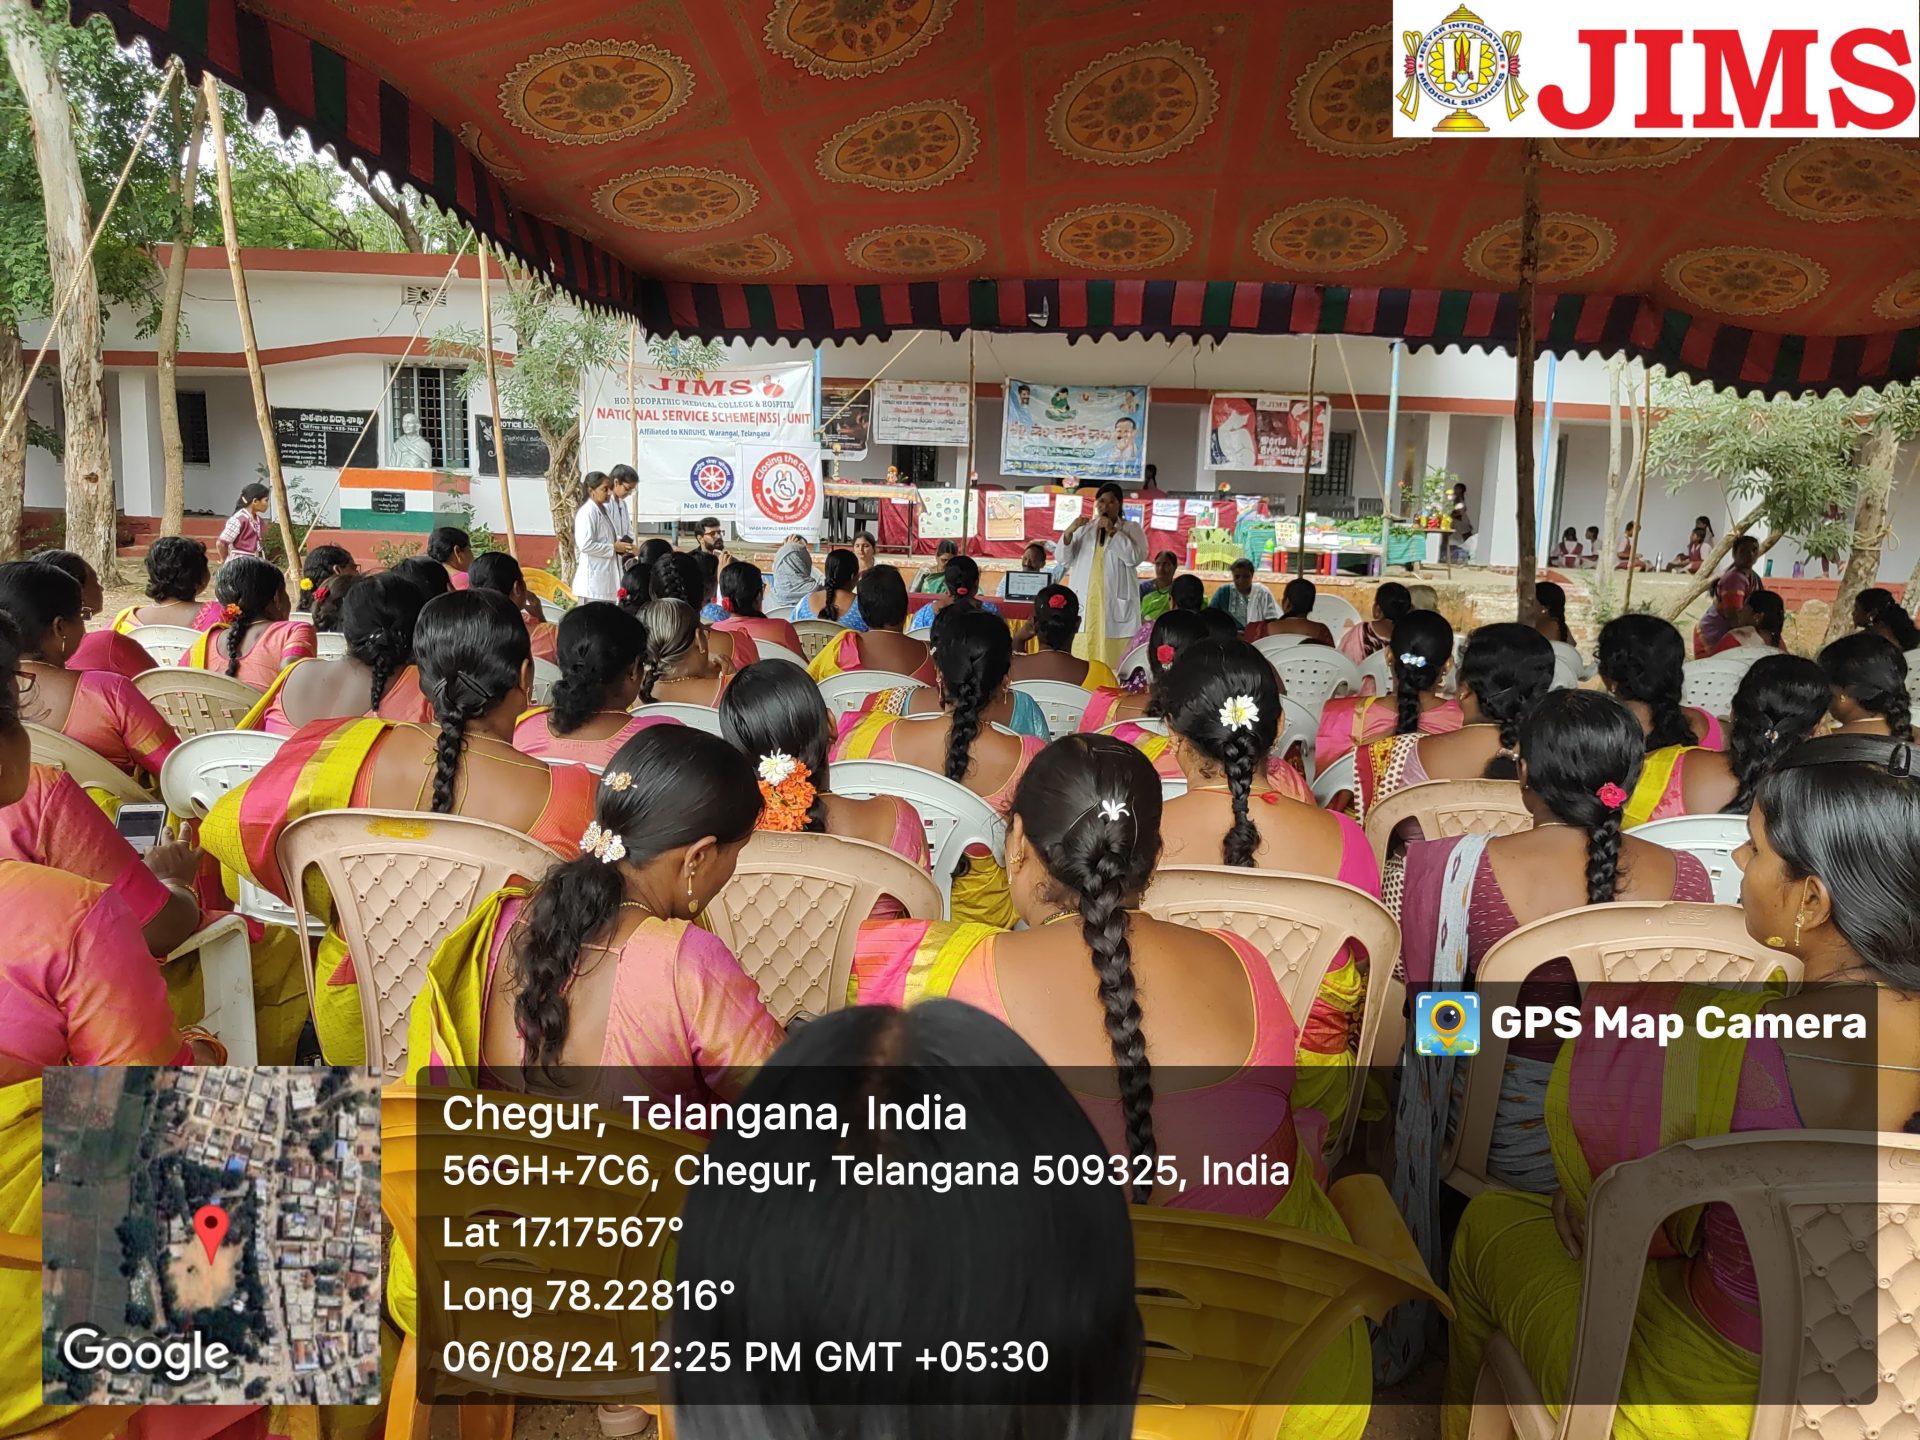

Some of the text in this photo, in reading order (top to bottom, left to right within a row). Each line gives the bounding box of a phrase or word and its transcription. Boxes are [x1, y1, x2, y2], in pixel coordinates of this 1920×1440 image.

[648, 377, 753, 396] JIMS
[682, 400, 717, 408] MEDICAL
[718, 400, 753, 409] COLLEGE
[762, 400, 795, 409] HOSPITAL
[662, 410, 709, 423] SERVICE
[787, 413, 811, 425] UNIT
[639, 428, 670, 436] Affiliated
[741, 430, 771, 439] Telangana
[1260, 436, 1287, 446] World
[755, 454, 811, 482] Closing the Gap
